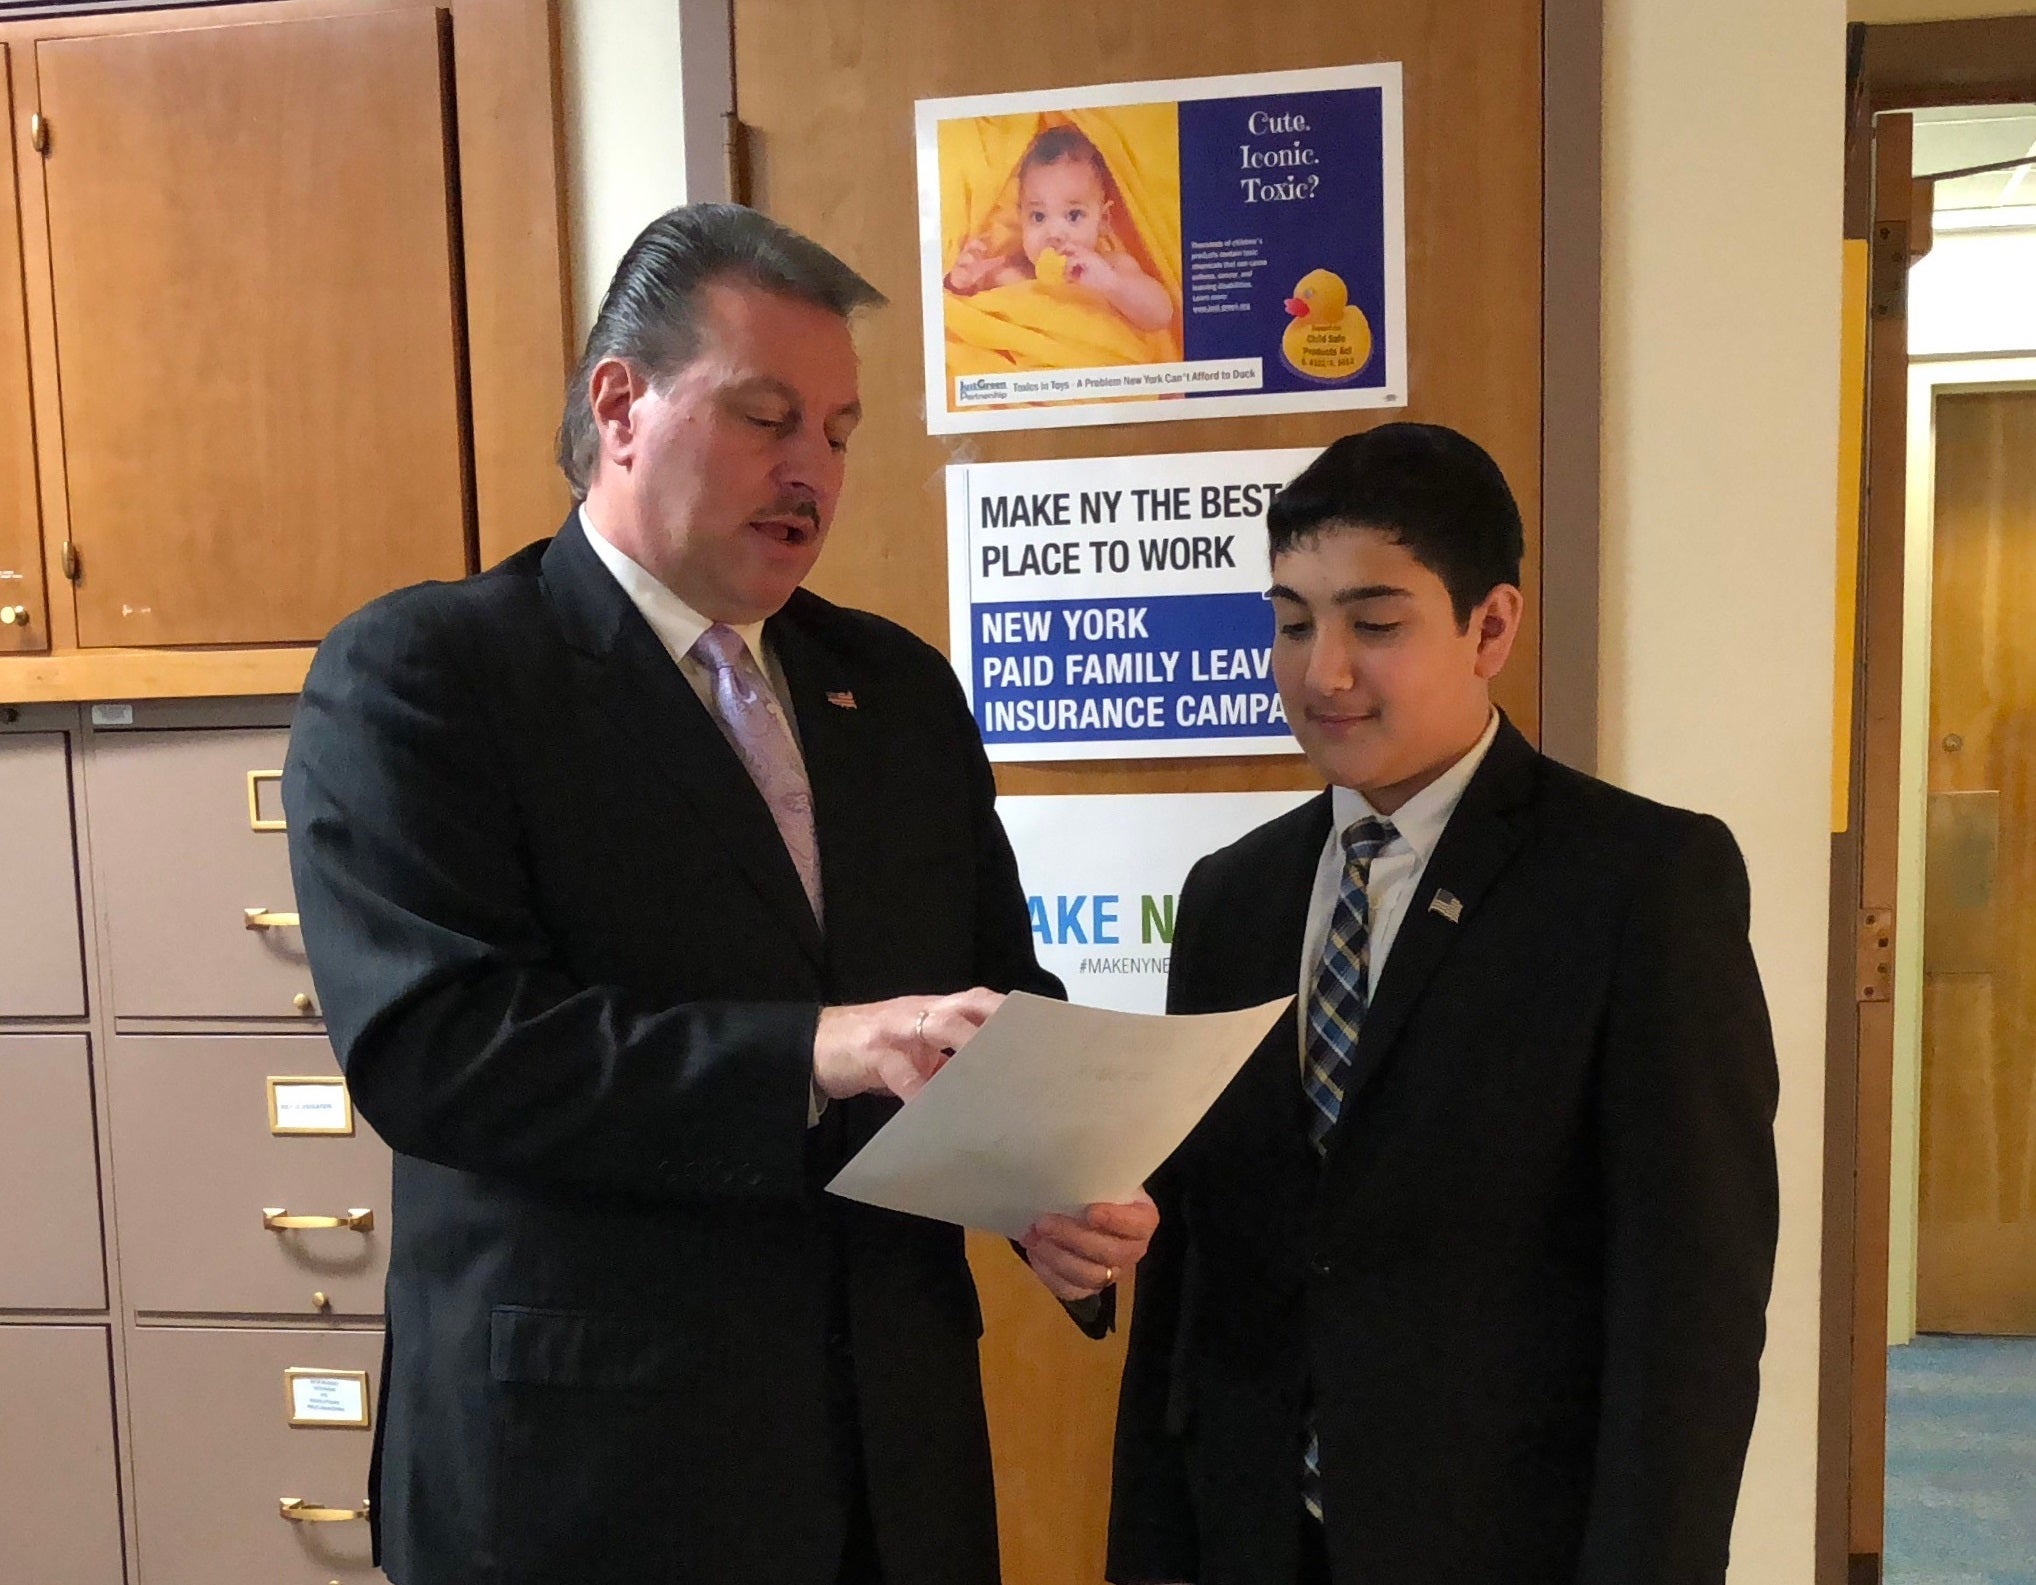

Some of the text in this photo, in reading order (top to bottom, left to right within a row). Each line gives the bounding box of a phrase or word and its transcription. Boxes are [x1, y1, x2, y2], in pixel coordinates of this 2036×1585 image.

[1248, 111, 1311, 135] Cute.
[1240, 141, 1320, 169] Iconic.
[1240, 174, 1320, 203] Toxic?
[1302, 347, 1337, 356] Products
[1306, 334, 1346, 343] Child Safe
[1013, 382, 1039, 392] Toxics
[1040, 382, 1049, 390] in
[1050, 380, 1069, 391] Toys
[1076, 379, 1083, 388] A
[1085, 376, 1122, 388] Problem
[1123, 375, 1142, 386] New
[1143, 374, 1163, 385] York
[1164, 372, 1190, 384] Can't
[1191, 370, 1219, 382] Afford
[1221, 370, 1230, 380] to
[1233, 369, 1256, 380] Duck
[960, 391, 1007, 401] Partnership
[981, 483, 1283, 528] MAKE NY THE BEST
[982, 535, 1236, 577] PLACE TO WORK
[981, 607, 1149, 644] NEW YORK
[983, 648, 1272, 688] PAID FAMILY LEAV
[985, 693, 1288, 732] INSURANCE CAMPA
[1027, 894, 1177, 945] AKE N
[1079, 957, 1170, 974] #MAKENYNE
